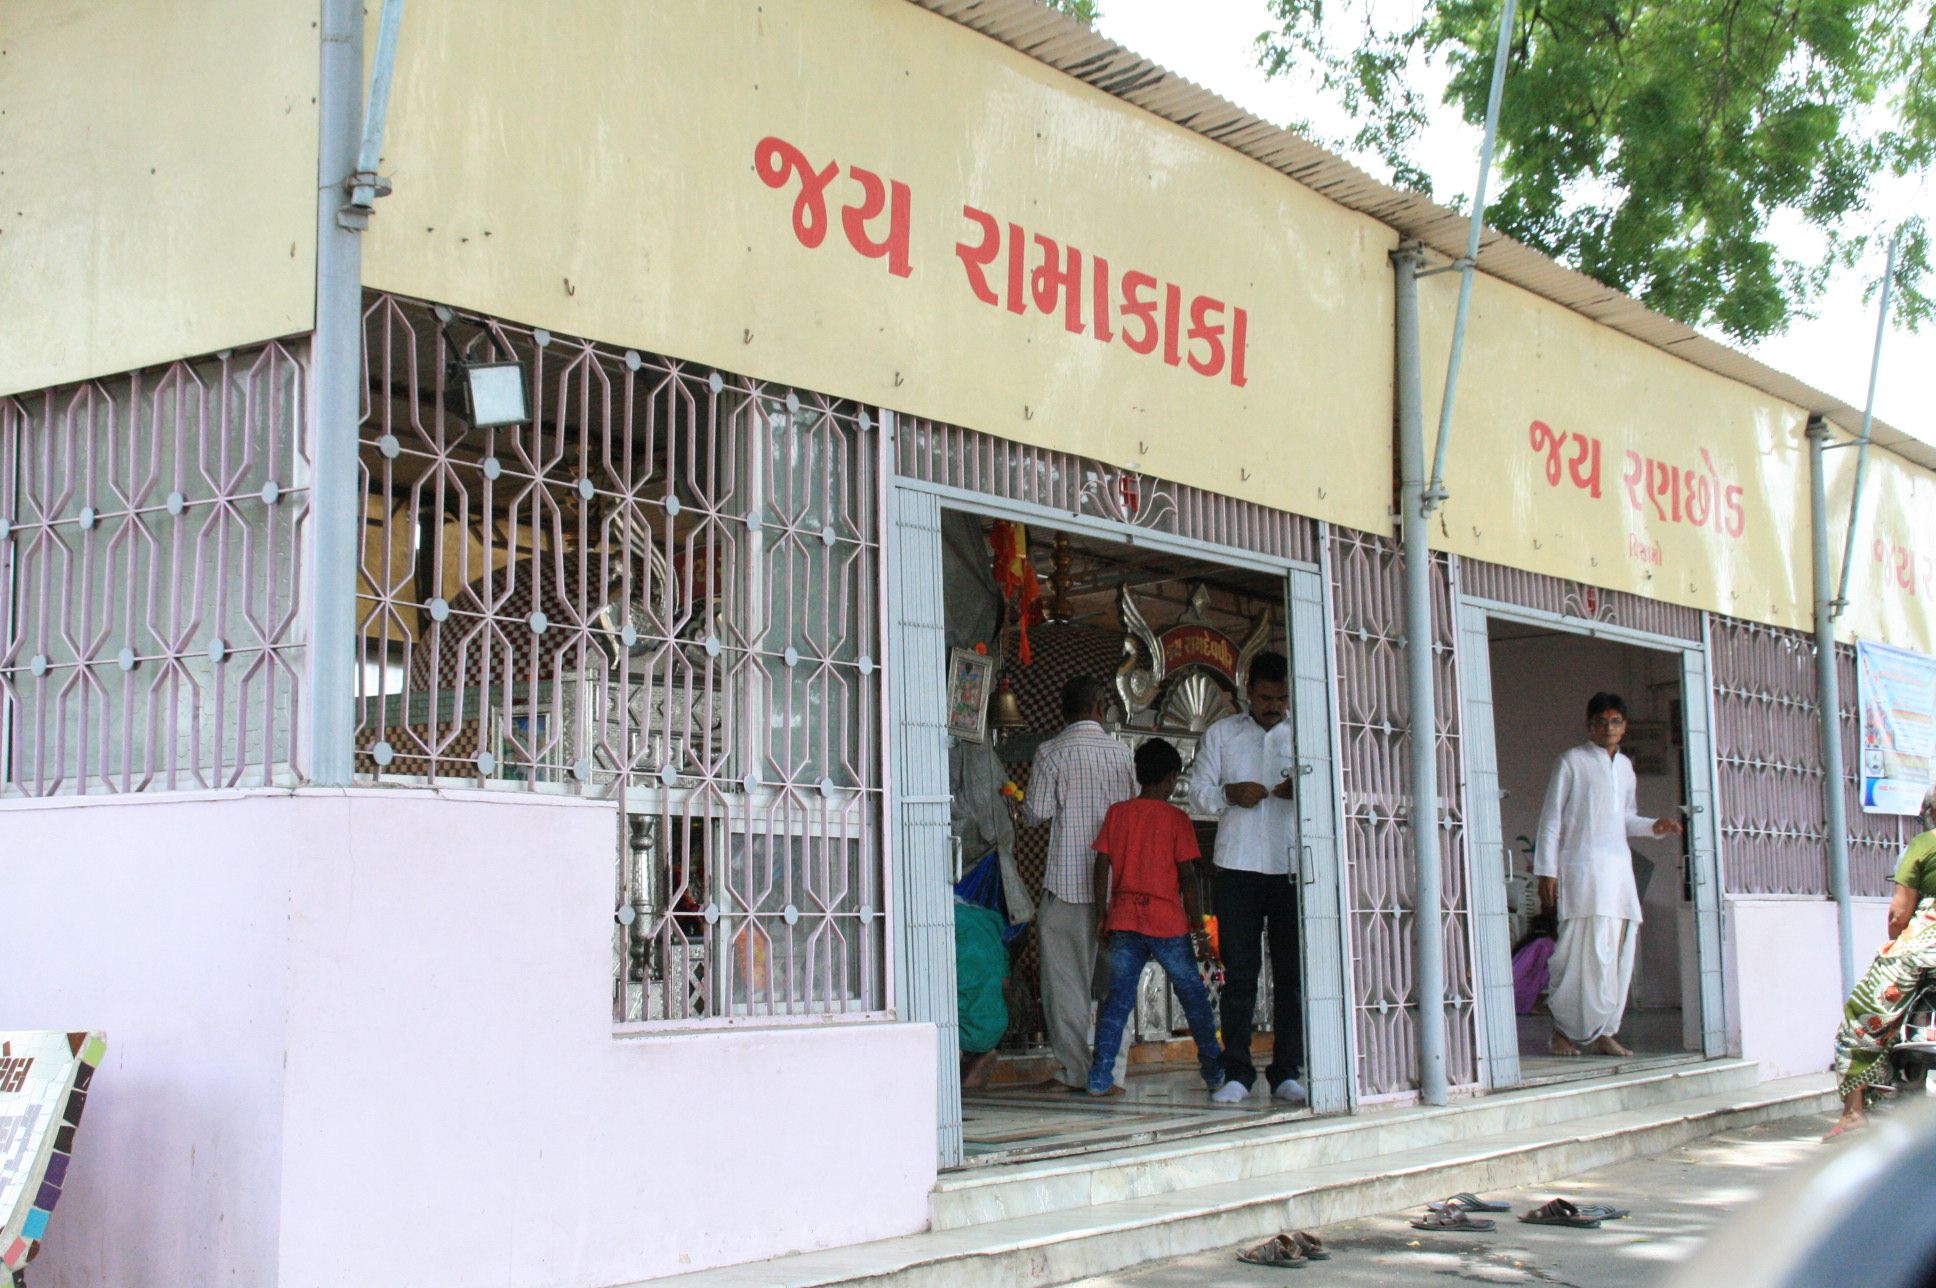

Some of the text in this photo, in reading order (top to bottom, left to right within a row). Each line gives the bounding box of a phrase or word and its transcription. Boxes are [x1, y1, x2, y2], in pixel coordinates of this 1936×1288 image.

[754, 135, 1248, 388] જય રામાકાકા
[1529, 420, 1745, 538] જય રણછોડ
[1873, 538, 1916, 597] જય
